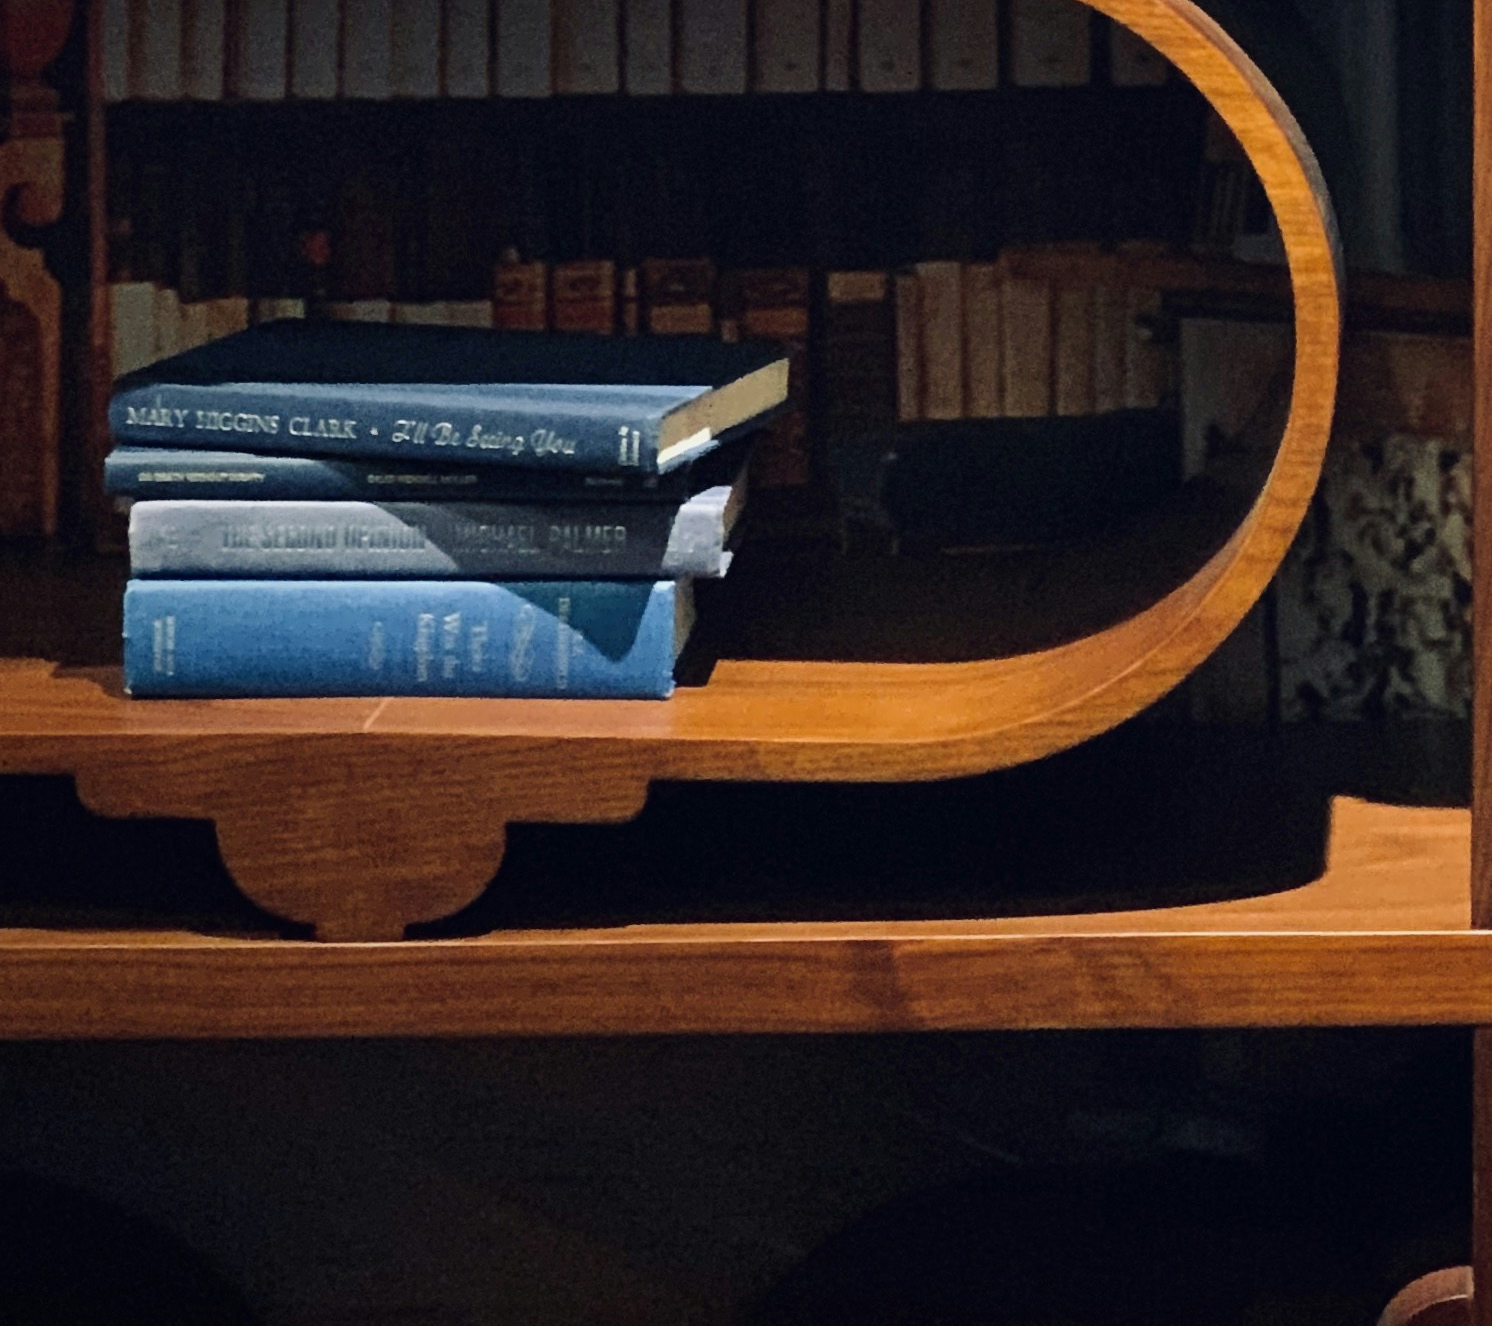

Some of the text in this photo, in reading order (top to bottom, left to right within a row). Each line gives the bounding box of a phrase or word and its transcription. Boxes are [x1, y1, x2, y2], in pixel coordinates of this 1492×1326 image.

[126, 407, 358, 439] MARY HIGGINS CLARK
[432, 422, 461, 447] Be
[466, 424, 524, 455] Seeing
[530, 429, 576, 456] You
